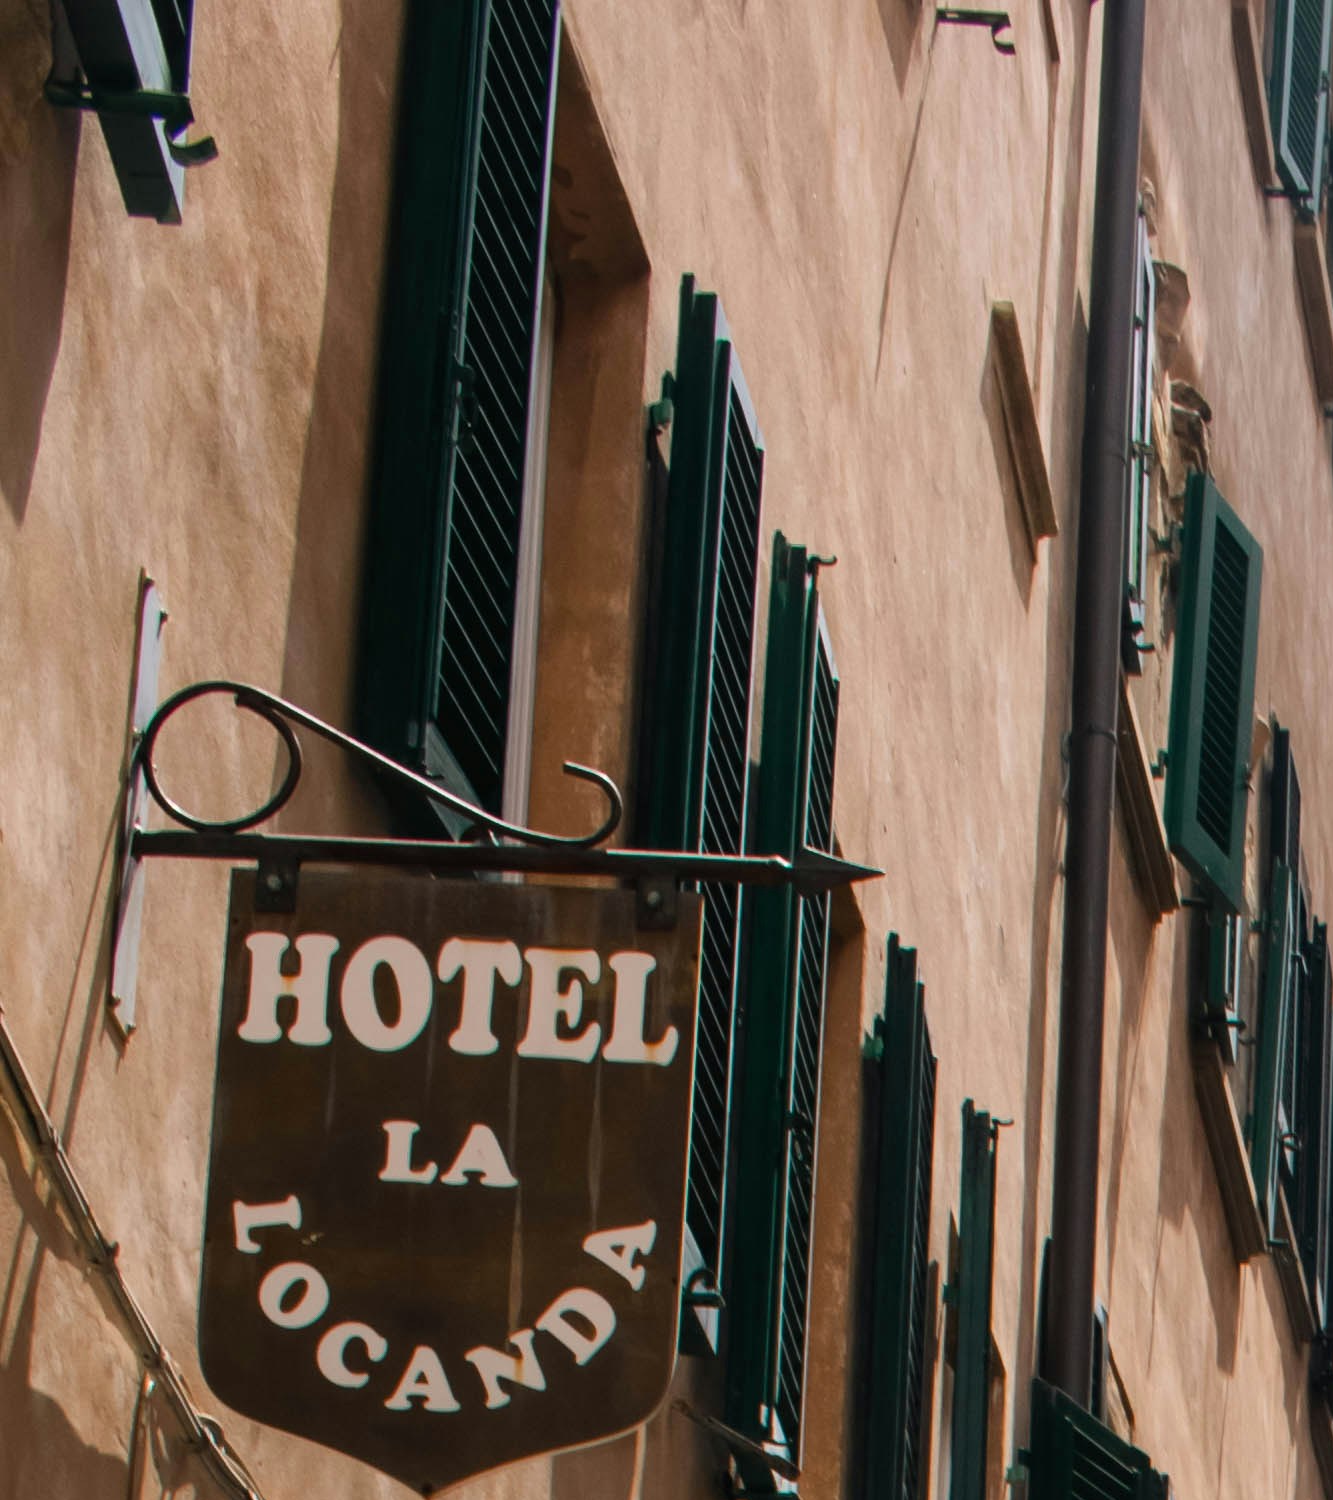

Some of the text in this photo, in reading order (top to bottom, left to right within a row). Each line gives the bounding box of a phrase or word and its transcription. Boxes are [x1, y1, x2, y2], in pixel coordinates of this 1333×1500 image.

[236, 931, 679, 1067] HOTEL
[378, 1120, 518, 1188] LA
[232, 1194, 659, 1413] LOCANDA
